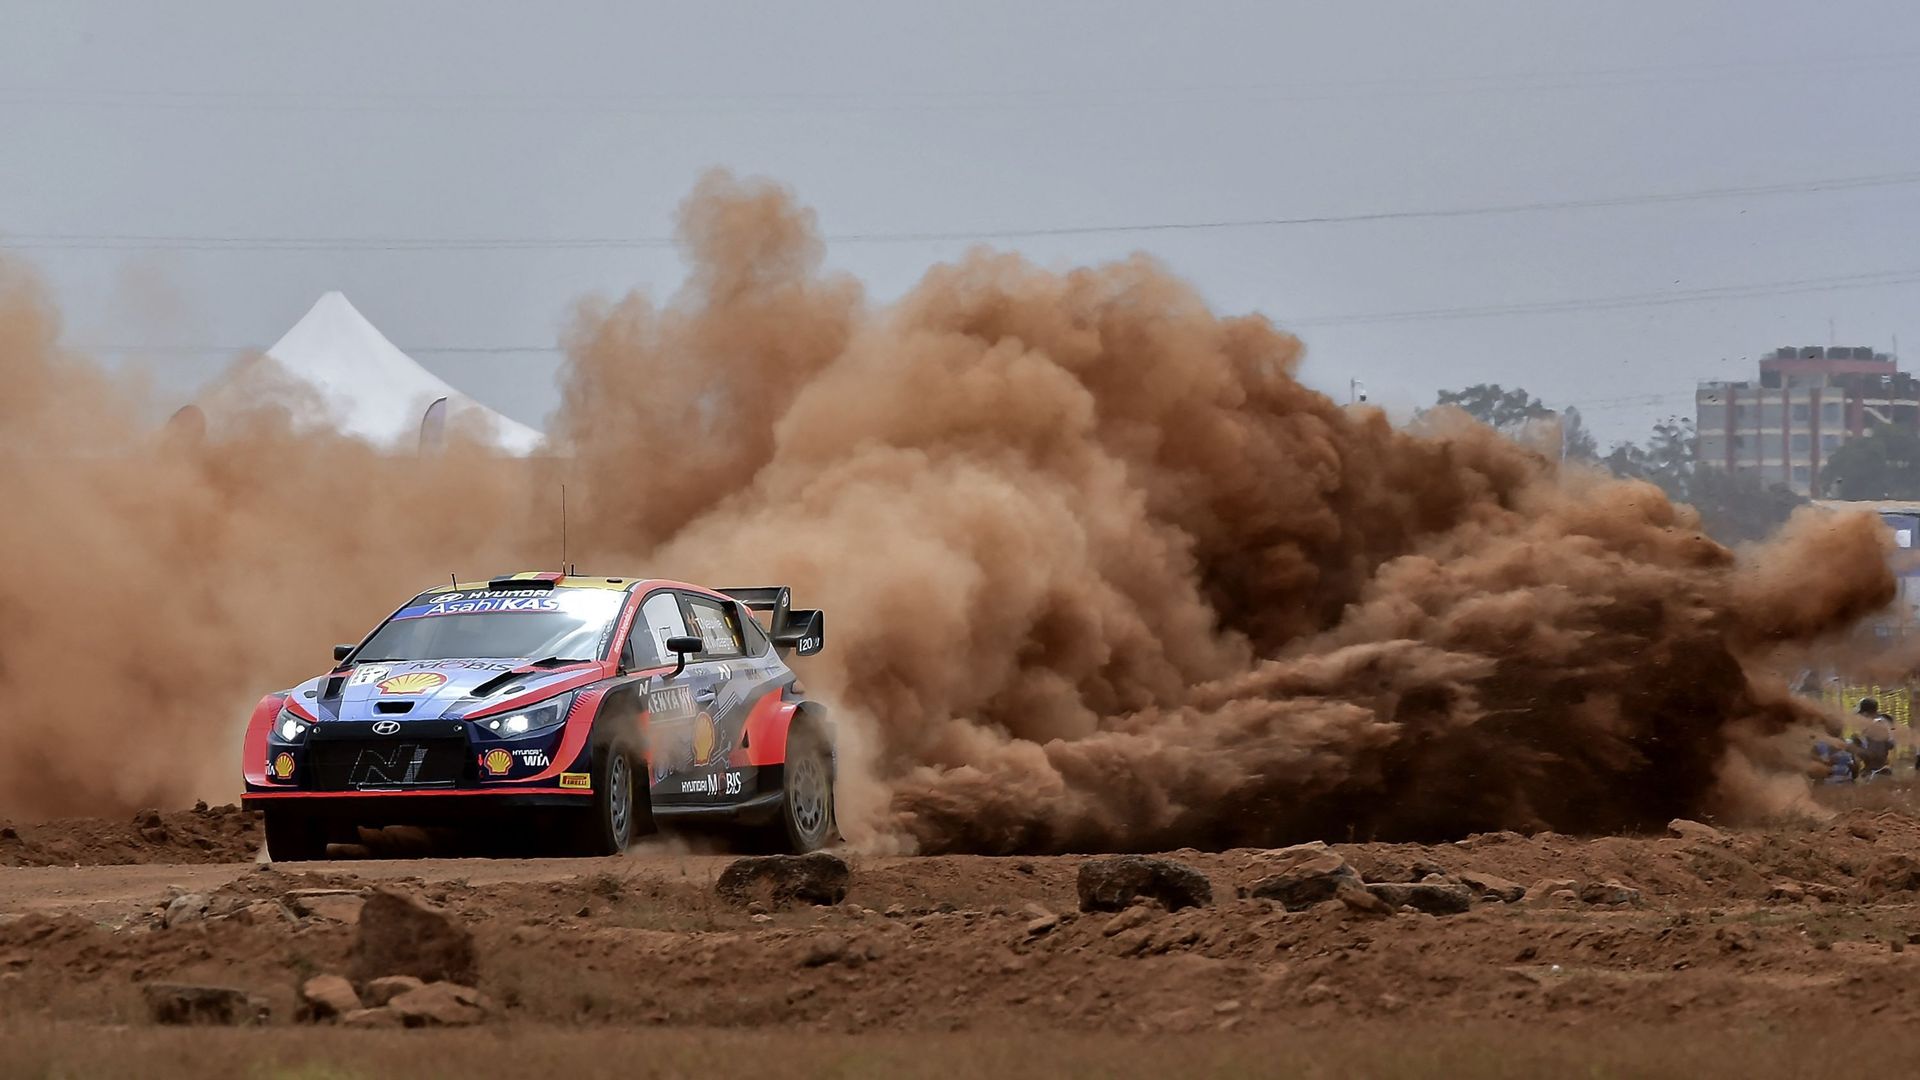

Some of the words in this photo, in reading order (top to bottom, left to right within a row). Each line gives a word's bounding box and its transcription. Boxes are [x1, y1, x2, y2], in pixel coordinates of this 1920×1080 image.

[468, 589, 554, 599] HYUNDAI
[410, 660, 513, 672] MOBIS
[648, 690, 680, 714] KENYA
[523, 754, 550, 766] WIA
[681, 779, 707, 792] HYUNDAI
[707, 772, 742, 795] MOBIS
